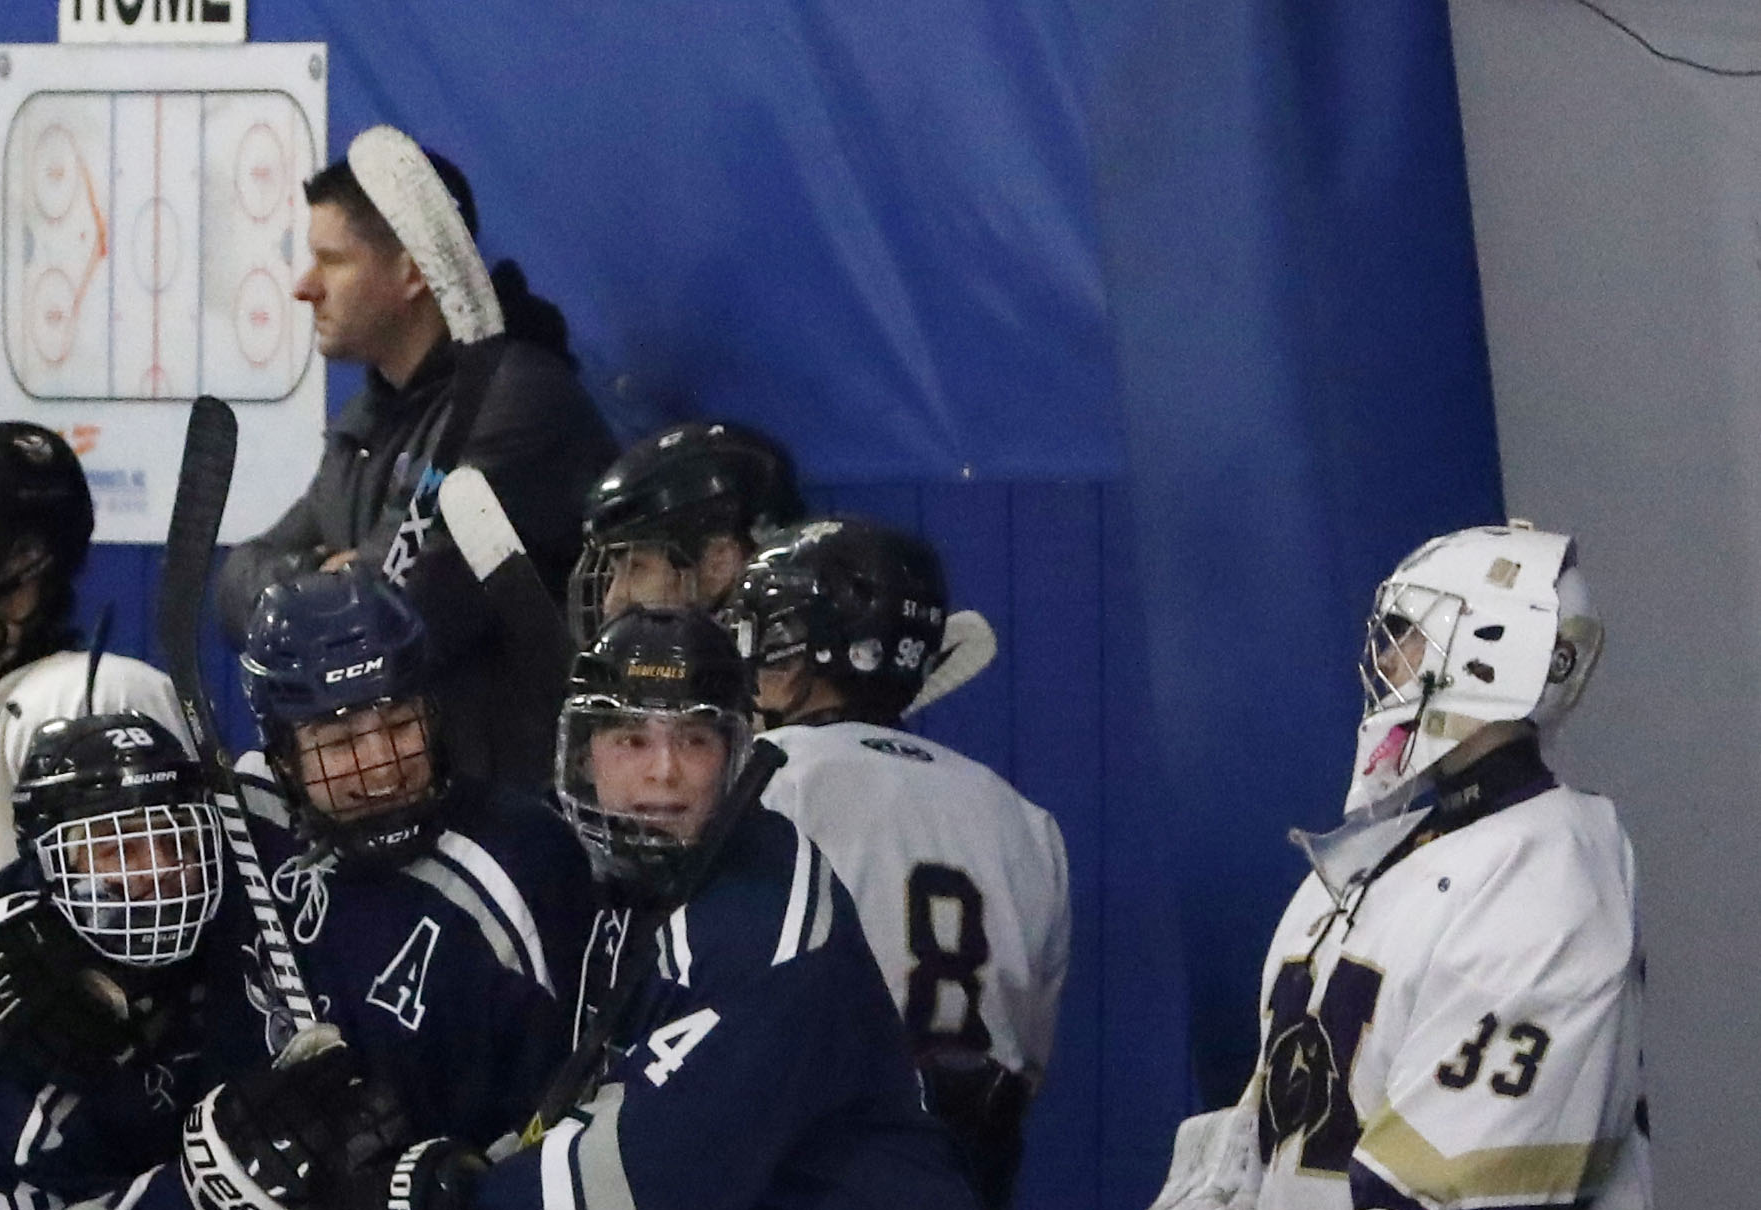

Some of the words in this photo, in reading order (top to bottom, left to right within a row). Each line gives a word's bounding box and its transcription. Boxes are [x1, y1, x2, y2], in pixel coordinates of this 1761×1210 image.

[325, 656, 384, 684] CCM
[104, 726, 154, 750] 28
[120, 770, 178, 787] BAUER
[365, 915, 441, 1031] A
[903, 862, 993, 1052] 8
[643, 1007, 721, 1088] 4
[1436, 1011, 1551, 1098] 33
